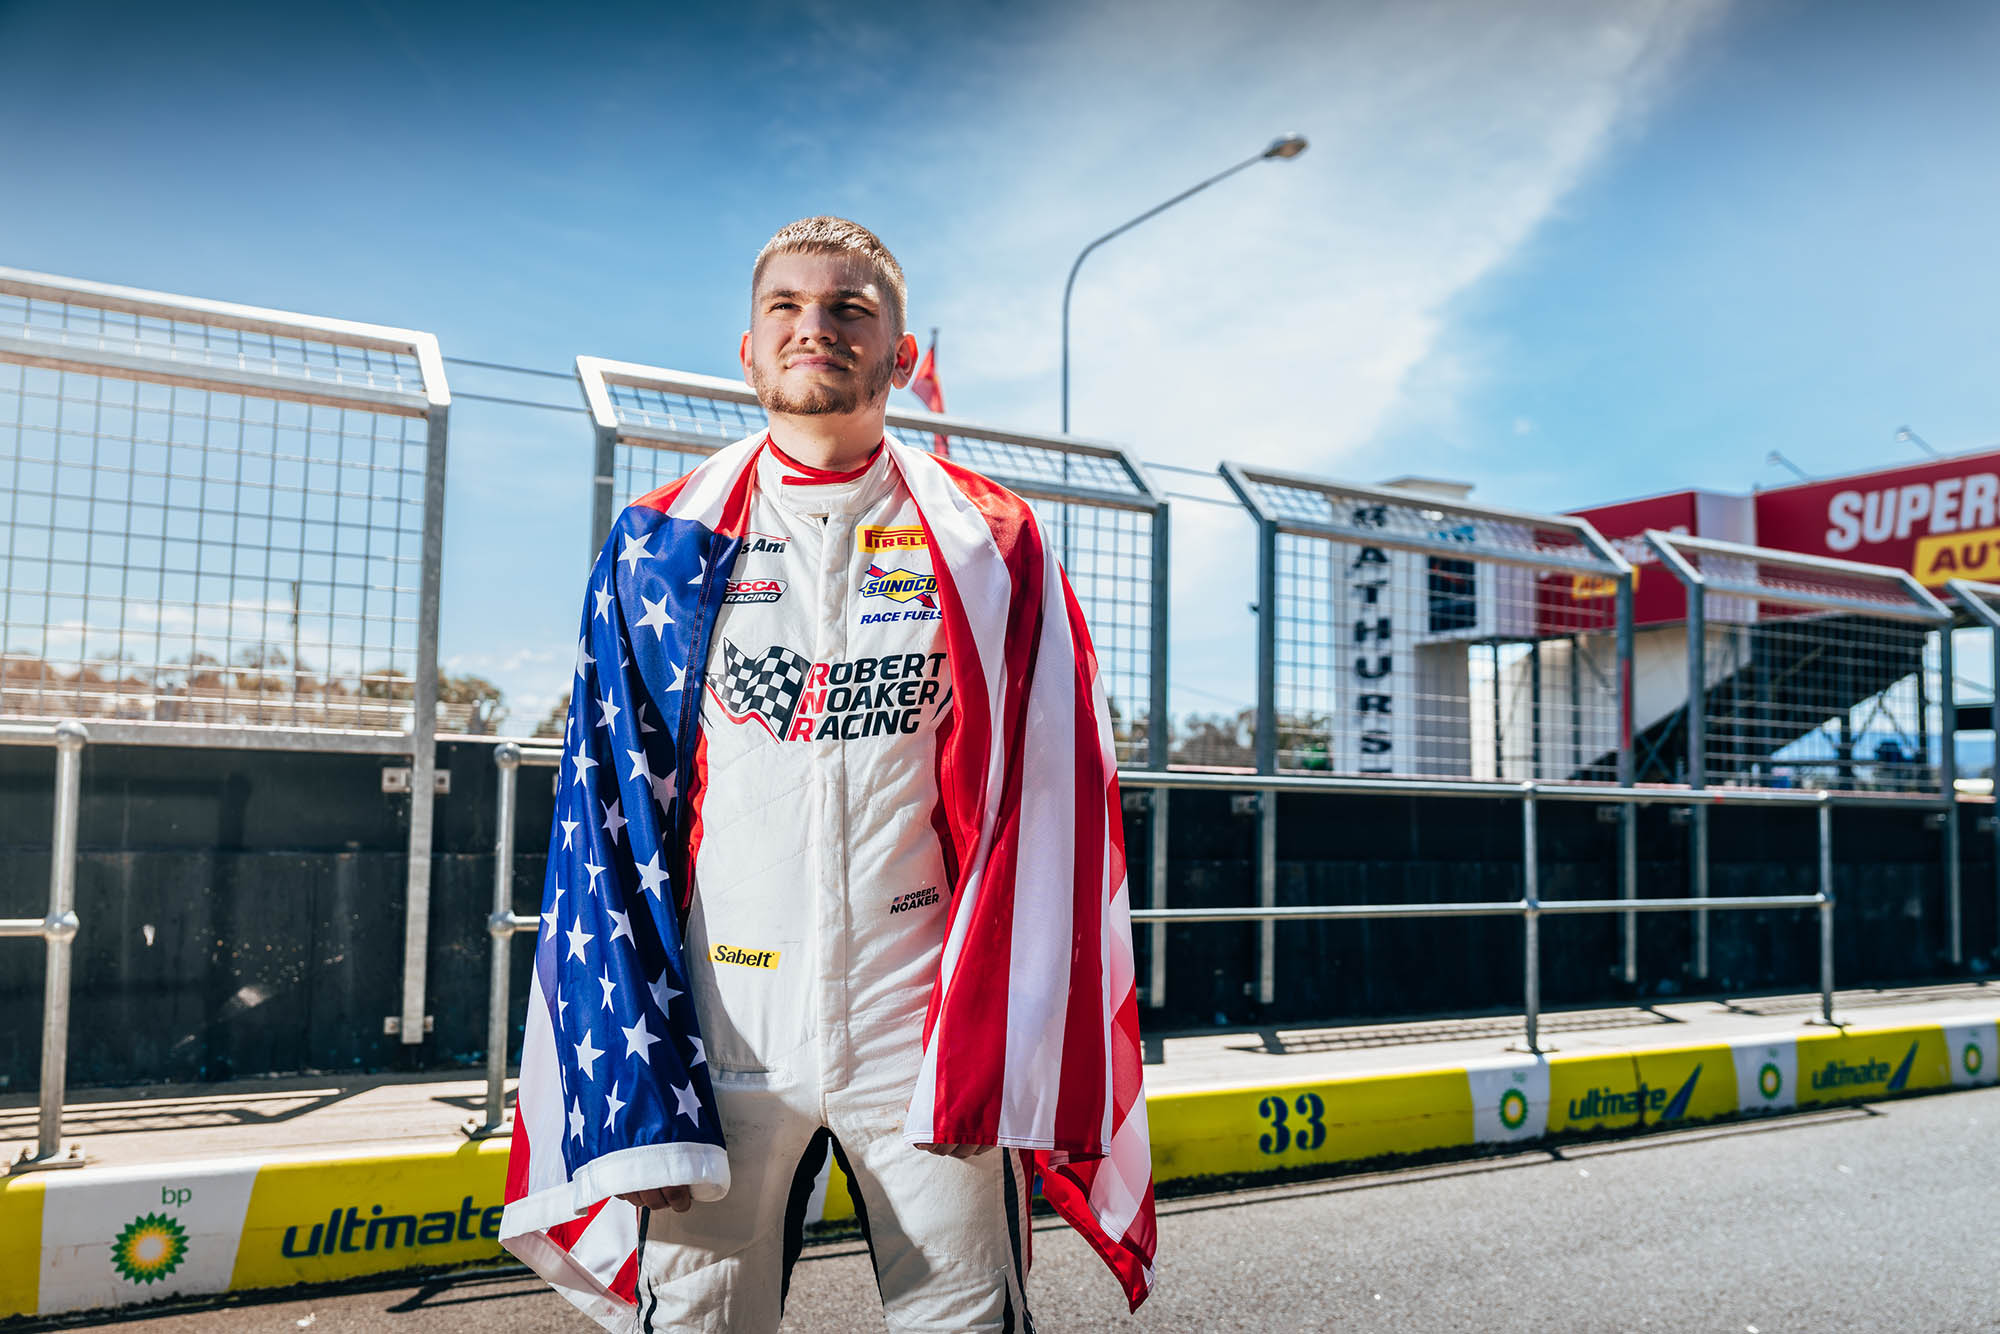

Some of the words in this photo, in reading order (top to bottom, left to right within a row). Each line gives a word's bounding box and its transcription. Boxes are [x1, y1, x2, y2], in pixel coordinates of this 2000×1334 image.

[1825, 473, 2000, 552] SUPER
[741, 538, 786, 554] sAm
[864, 529, 928, 549] PIRELL
[1929, 541, 2000, 575] AU
[725, 581, 782, 593] SCCA
[725, 593, 778, 603] RACING
[866, 577, 937, 595] SUNOCO
[860, 611, 901, 624] RACE
[903, 610, 943, 621] FUELS
[807, 652, 947, 689] ROBERT
[798, 680, 940, 715] NOAKER
[789, 709, 922, 742] RACING
[890, 893, 940, 915] NOAKER
[903, 886, 937, 902] ROBERT
[714, 944, 772, 968] Sabelt
[1812, 1056, 1891, 1090] ultimate
[1568, 1083, 1668, 1120] ultimate
[1258, 1092, 1327, 1155] 33
[161, 1185, 192, 1208] bp
[281, 1195, 505, 1258] ultimate
